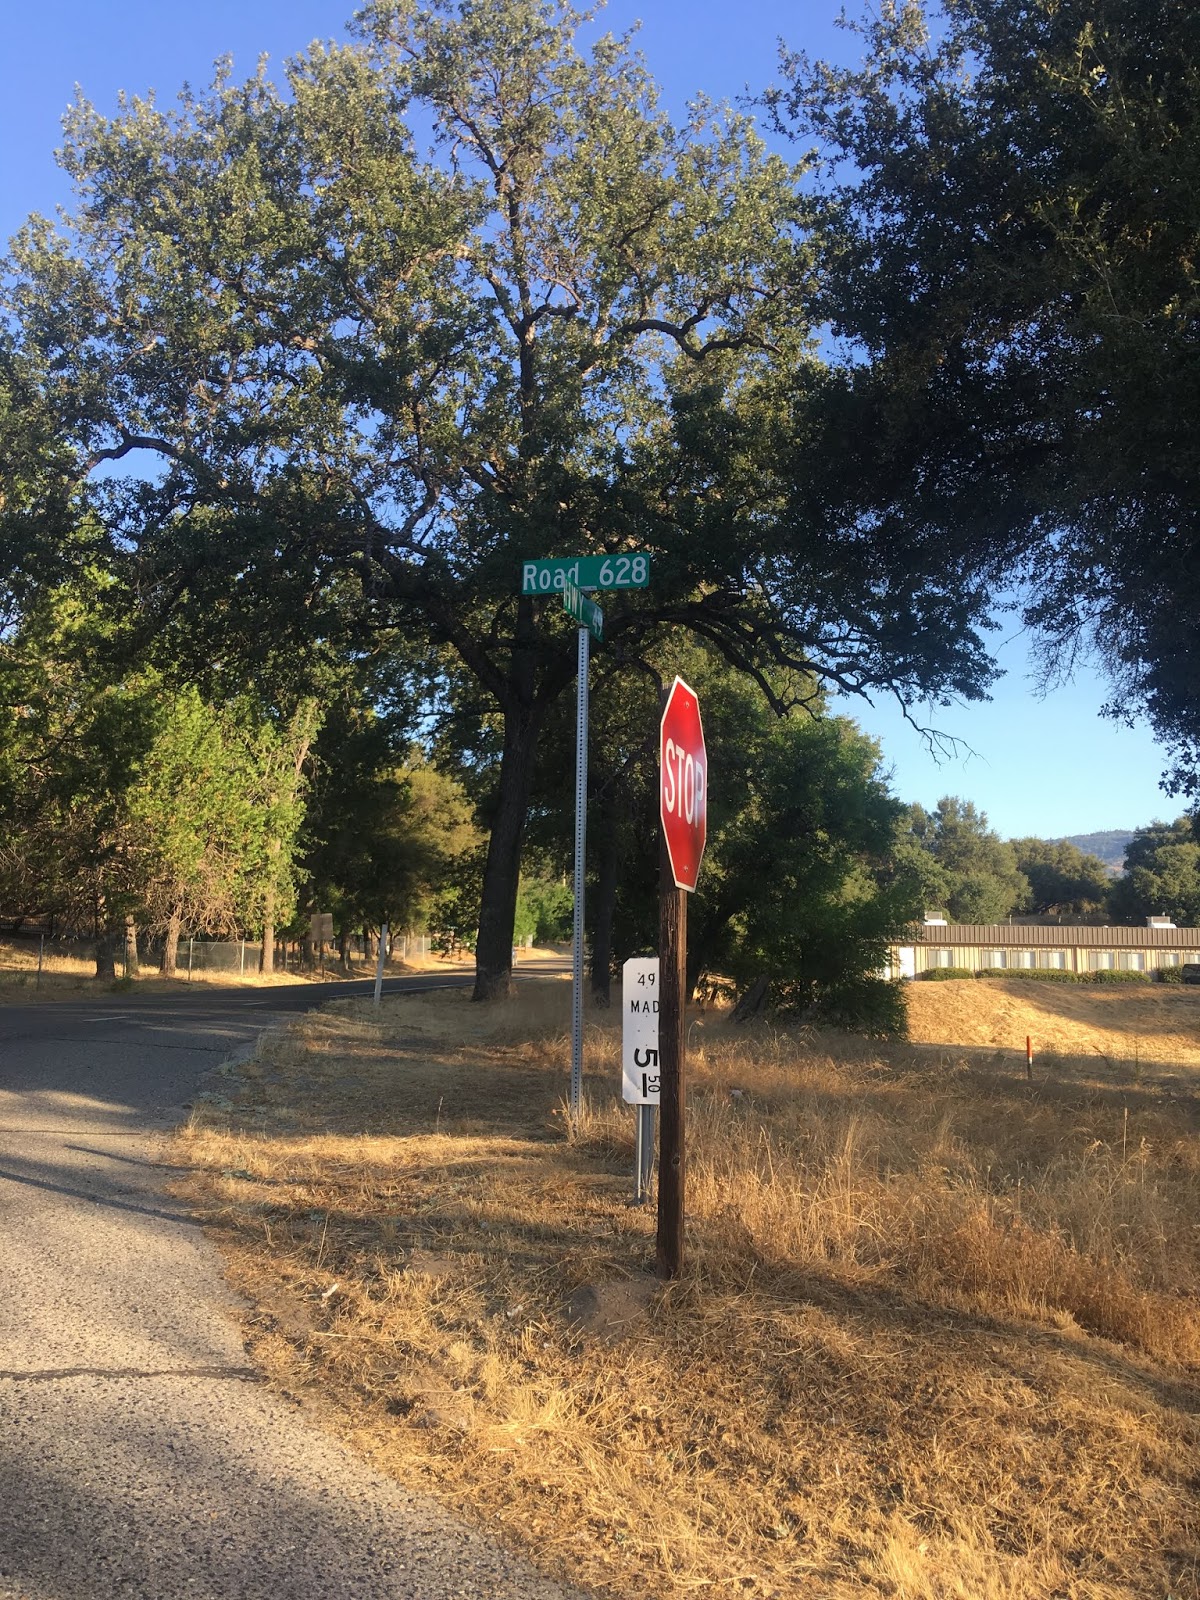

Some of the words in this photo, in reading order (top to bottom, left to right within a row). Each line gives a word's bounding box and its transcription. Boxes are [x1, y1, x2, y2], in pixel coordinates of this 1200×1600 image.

[523, 561, 579, 591] Road
[599, 556, 647, 586] 628
[664, 737, 704, 828] STOP
[637, 973, 655, 987] 49
[630, 1000, 660, 1013] MAD
